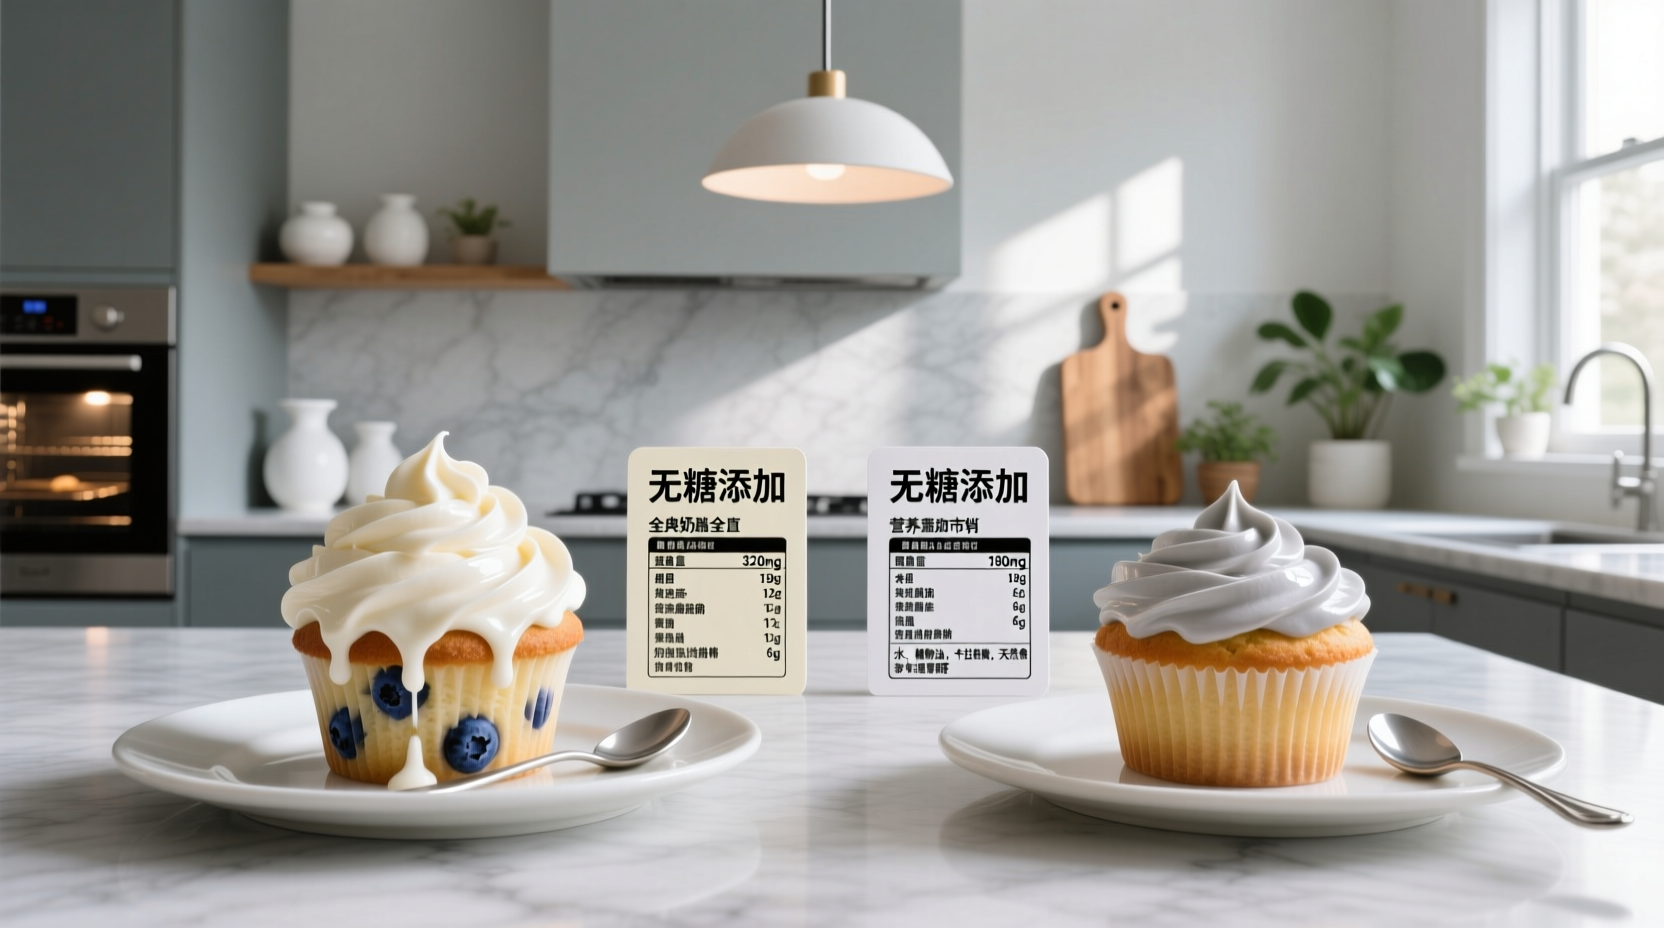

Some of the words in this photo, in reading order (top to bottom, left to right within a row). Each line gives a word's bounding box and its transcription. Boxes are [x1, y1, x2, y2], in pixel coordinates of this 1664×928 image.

[649, 468, 785, 503] 无糖添加
[890, 467, 1027, 503] 无糖添加
[742, 555, 781, 571] 320mg
